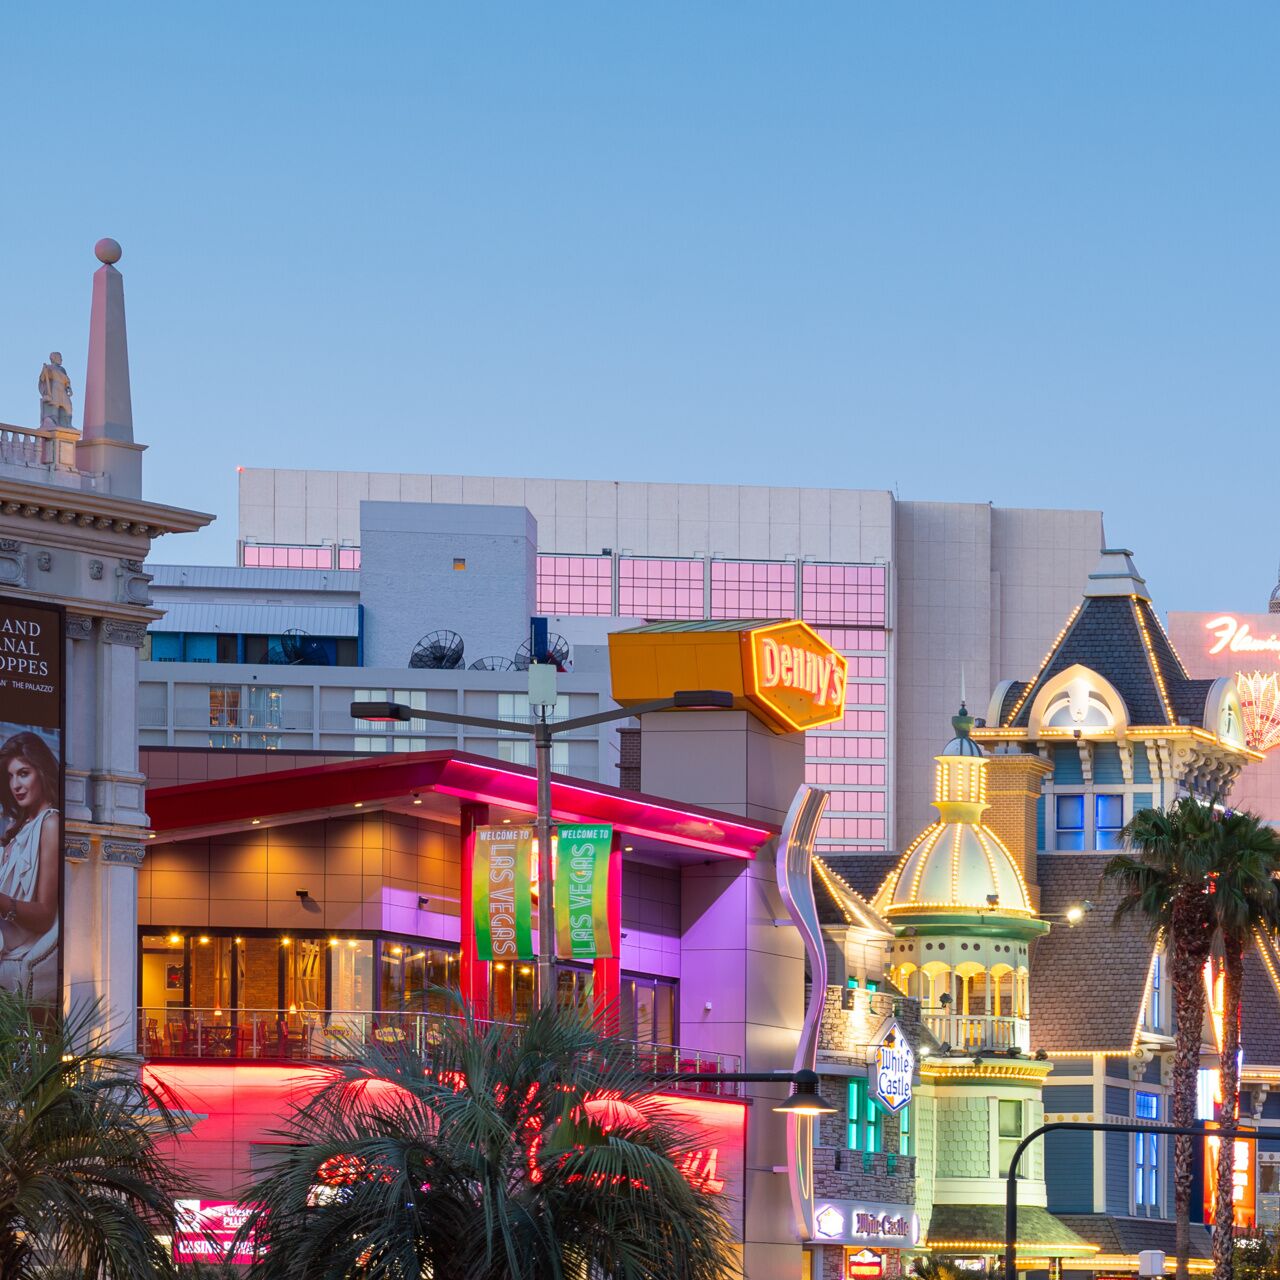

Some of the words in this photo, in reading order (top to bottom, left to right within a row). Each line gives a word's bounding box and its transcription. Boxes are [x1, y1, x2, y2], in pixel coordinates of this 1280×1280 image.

[12, 680, 24, 690] THE
[762, 637, 844, 706] Denny's
[480, 830, 518, 840] WELCOME
[519, 830, 529, 840] TO
[561, 829, 597, 839] WELCOME
[600, 830, 609, 839] TO
[490, 843, 516, 884] LAS
[570, 843, 595, 910] VEGAS
[490, 887, 516, 955] VEGAS
[570, 914, 596, 954] LAS
[881, 1048, 909, 1076] White
[879, 1073, 910, 1097] Castle
[856, 1213, 881, 1236] White
[881, 1214, 909, 1236] Castle
